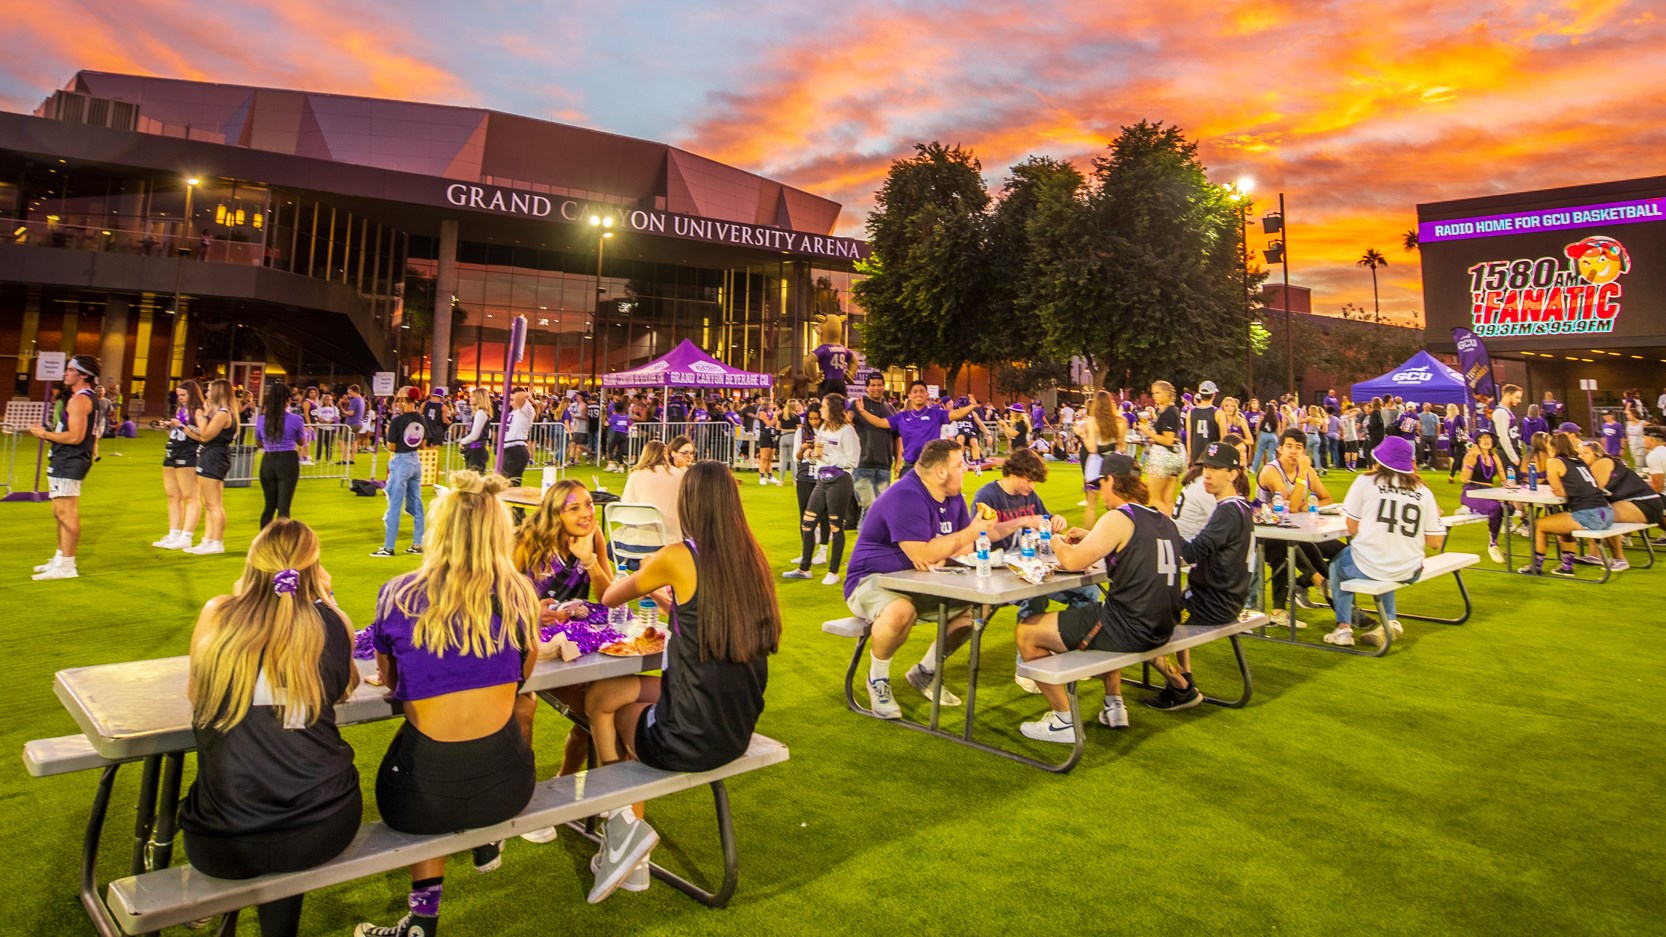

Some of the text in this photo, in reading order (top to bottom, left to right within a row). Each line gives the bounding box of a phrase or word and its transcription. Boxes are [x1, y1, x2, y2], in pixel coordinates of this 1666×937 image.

[446, 183, 552, 217] GRAND
[673, 215, 796, 250] UNIVERSITY
[800, 235, 860, 258] ARENA
[1434, 203, 1662, 237] RADIO HOME FOR GCU BASKETBALL
[1468, 257, 1580, 293] 1580 AM
[1482, 282, 1621, 325] FANATIC
[1475, 319, 1613, 337] 99.3FM & 95.9FM
[1456, 338, 1478, 351] GCU
[830, 353, 846, 370] 49
[670, 371, 695, 384] GRAND
[696, 372, 724, 385] CANYON
[725, 373, 759, 386] BEVERAGE
[1392, 371, 1434, 382] GCU
[1197, 419, 1209, 439] 4
[1576, 466, 1598, 488] 4
[1376, 498, 1421, 538] 49
[1156, 538, 1177, 587] 4
